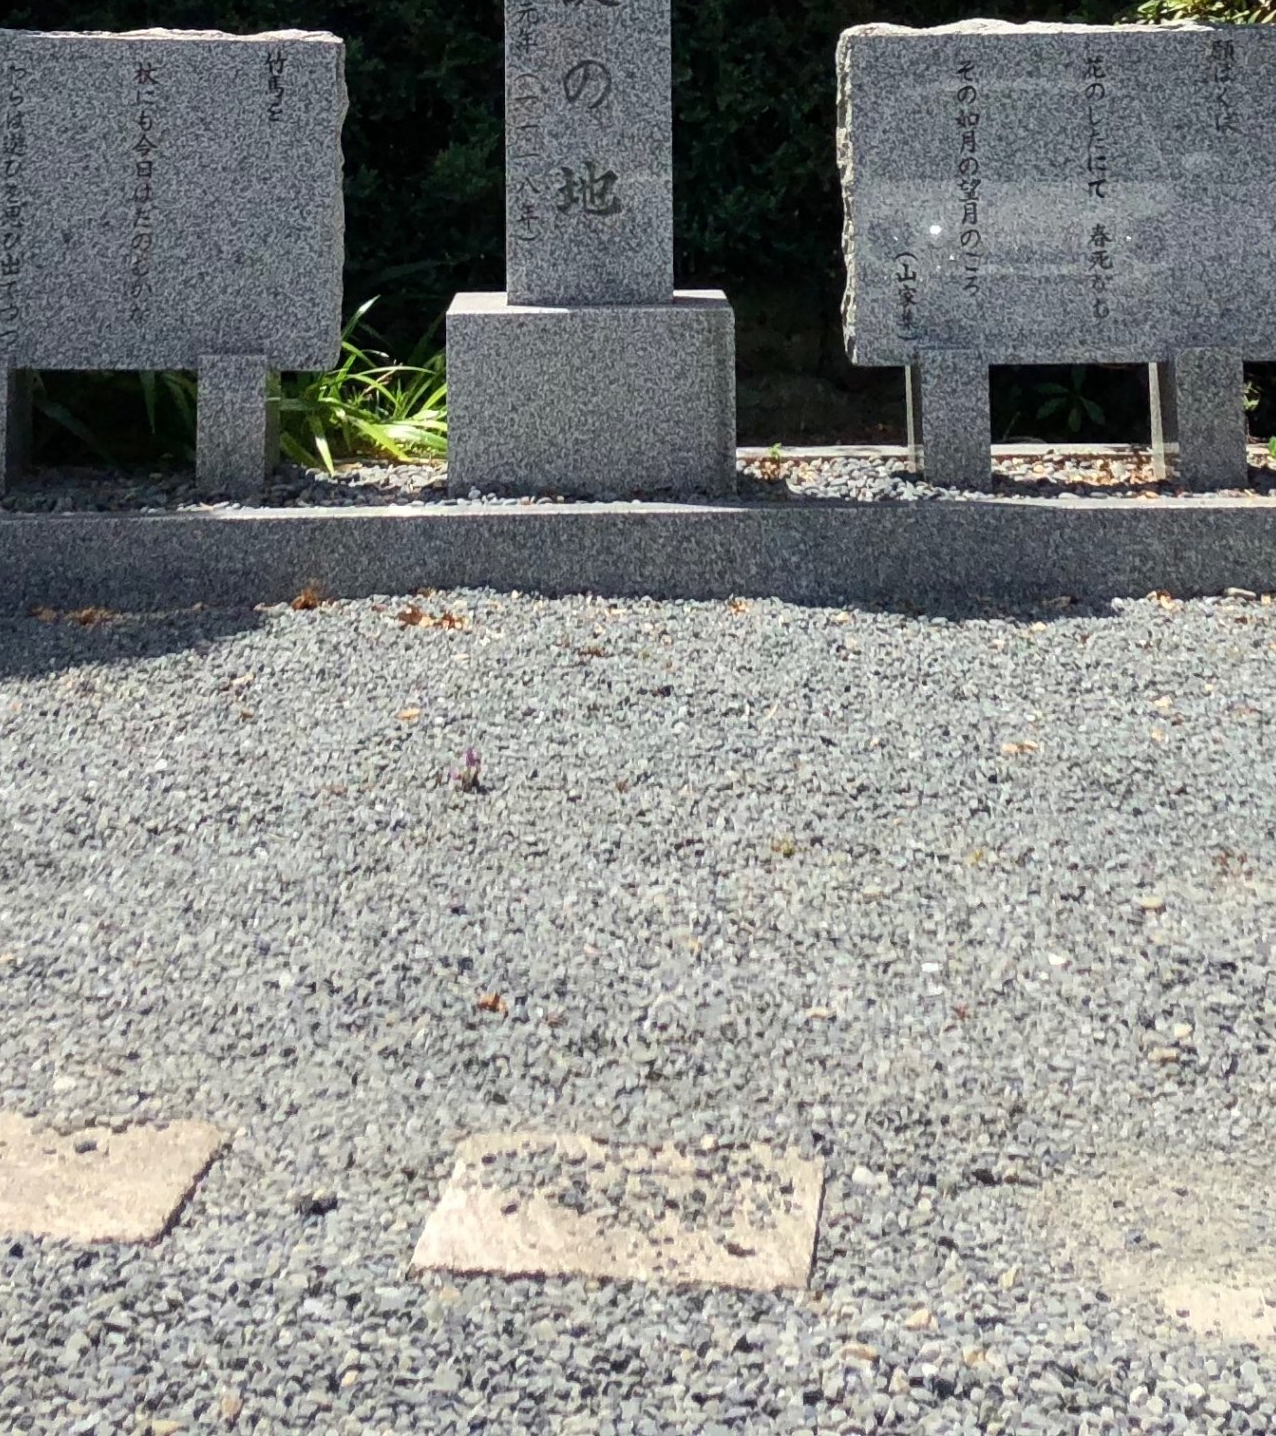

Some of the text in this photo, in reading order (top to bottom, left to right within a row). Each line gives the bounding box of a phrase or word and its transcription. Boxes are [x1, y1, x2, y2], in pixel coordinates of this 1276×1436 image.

[265, 51, 288, 122] 竹馬を
[1210, 39, 1240, 133] 願はくは
[956, 60, 983, 297] その如月の望月のころ
[1084, 57, 1114, 319] 花のしたにて 春死なむ
